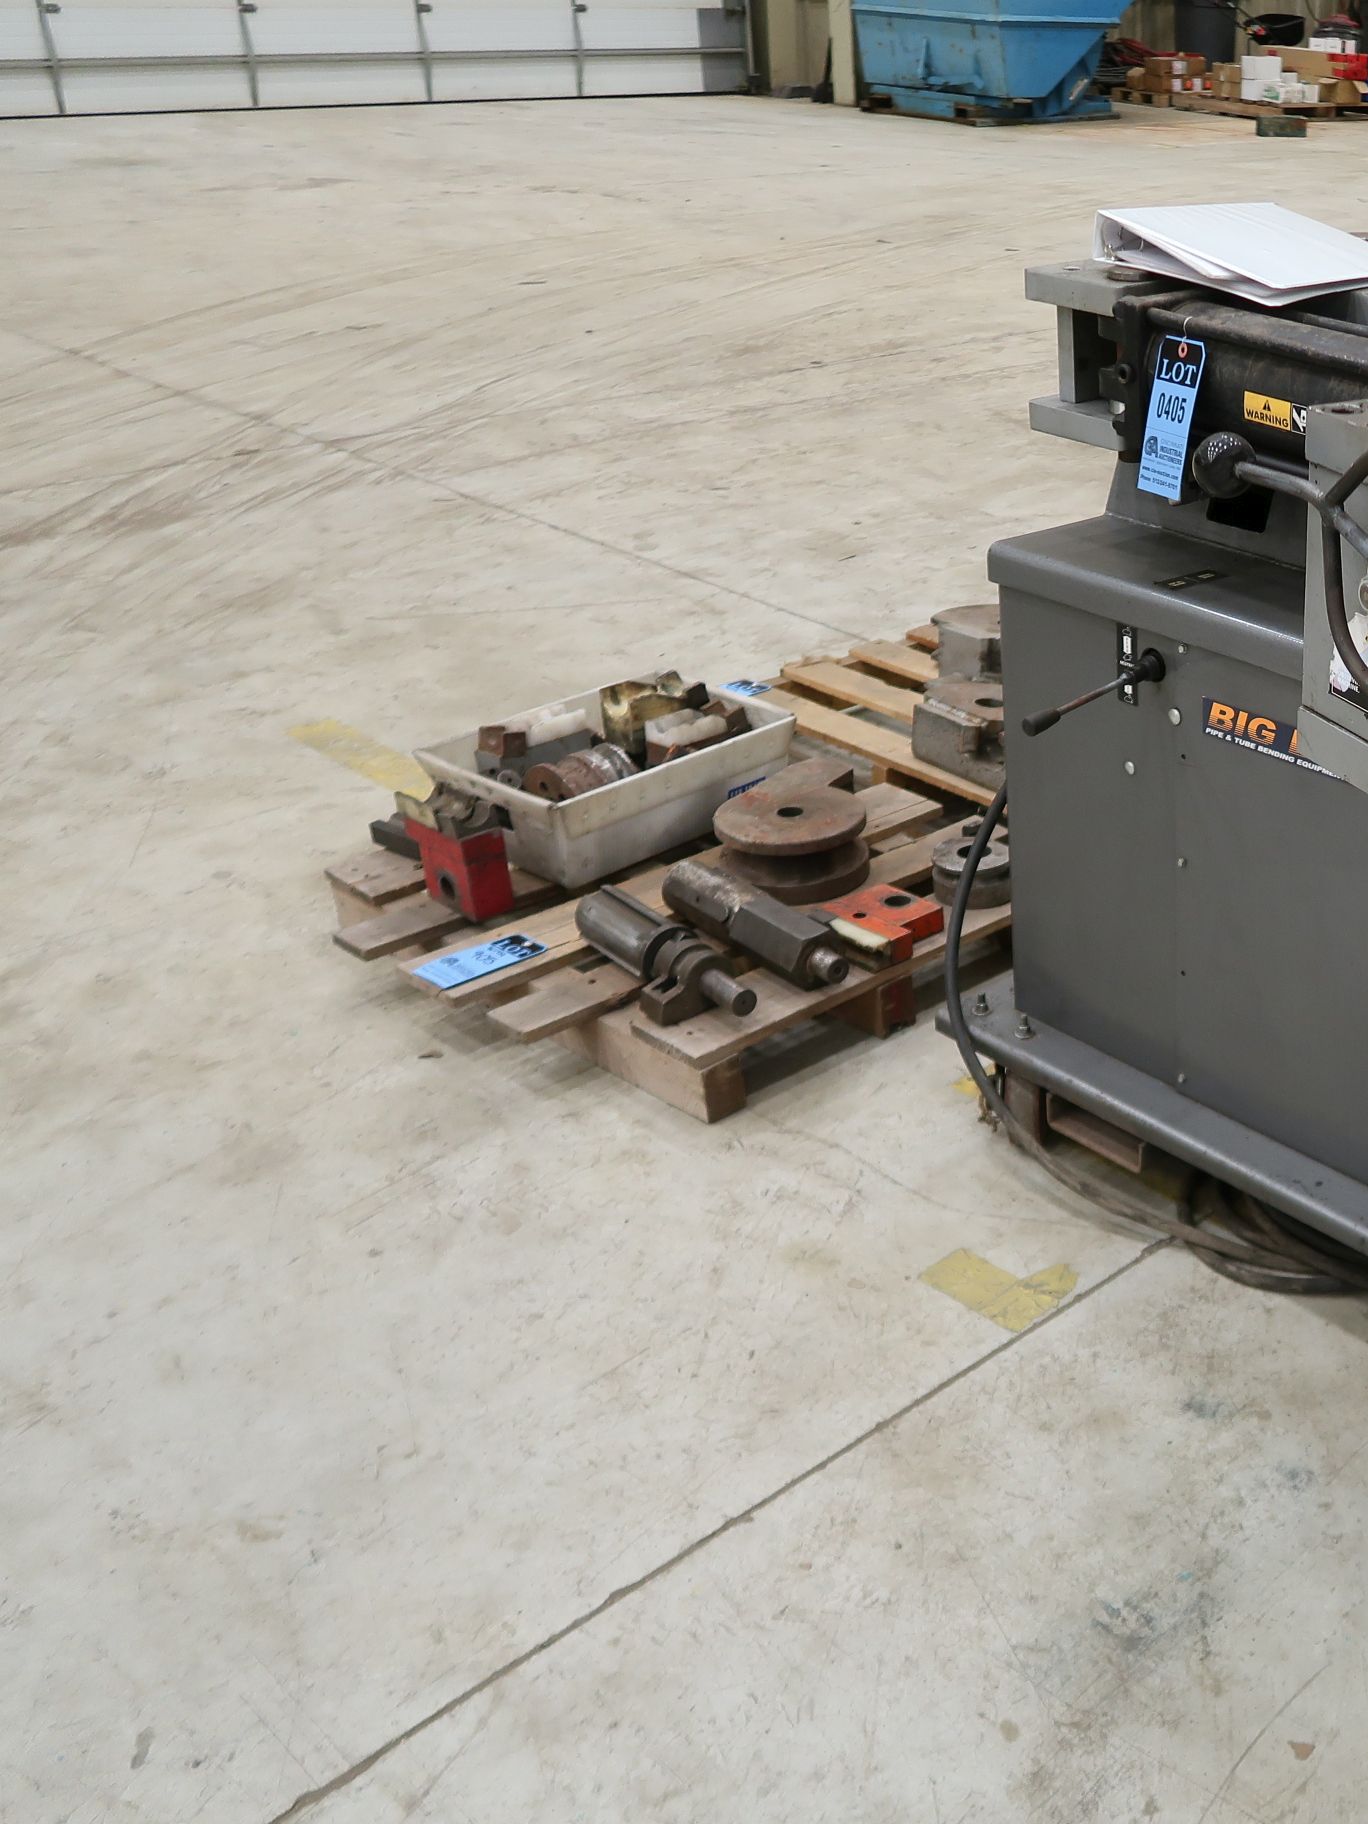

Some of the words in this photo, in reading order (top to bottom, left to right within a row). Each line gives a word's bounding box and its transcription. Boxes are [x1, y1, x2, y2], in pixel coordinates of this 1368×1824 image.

[1160, 358, 1197, 385] LOT
[1156, 392, 1188, 424] 0405
[1245, 407, 1289, 428] WARNING
[1208, 701, 1277, 746] BIG
[1205, 727, 1224, 739] PIPE
[1234, 736, 1256, 750] TUBE
[1257, 745, 1295, 763] BENDING
[493, 938, 533, 958] LOT
